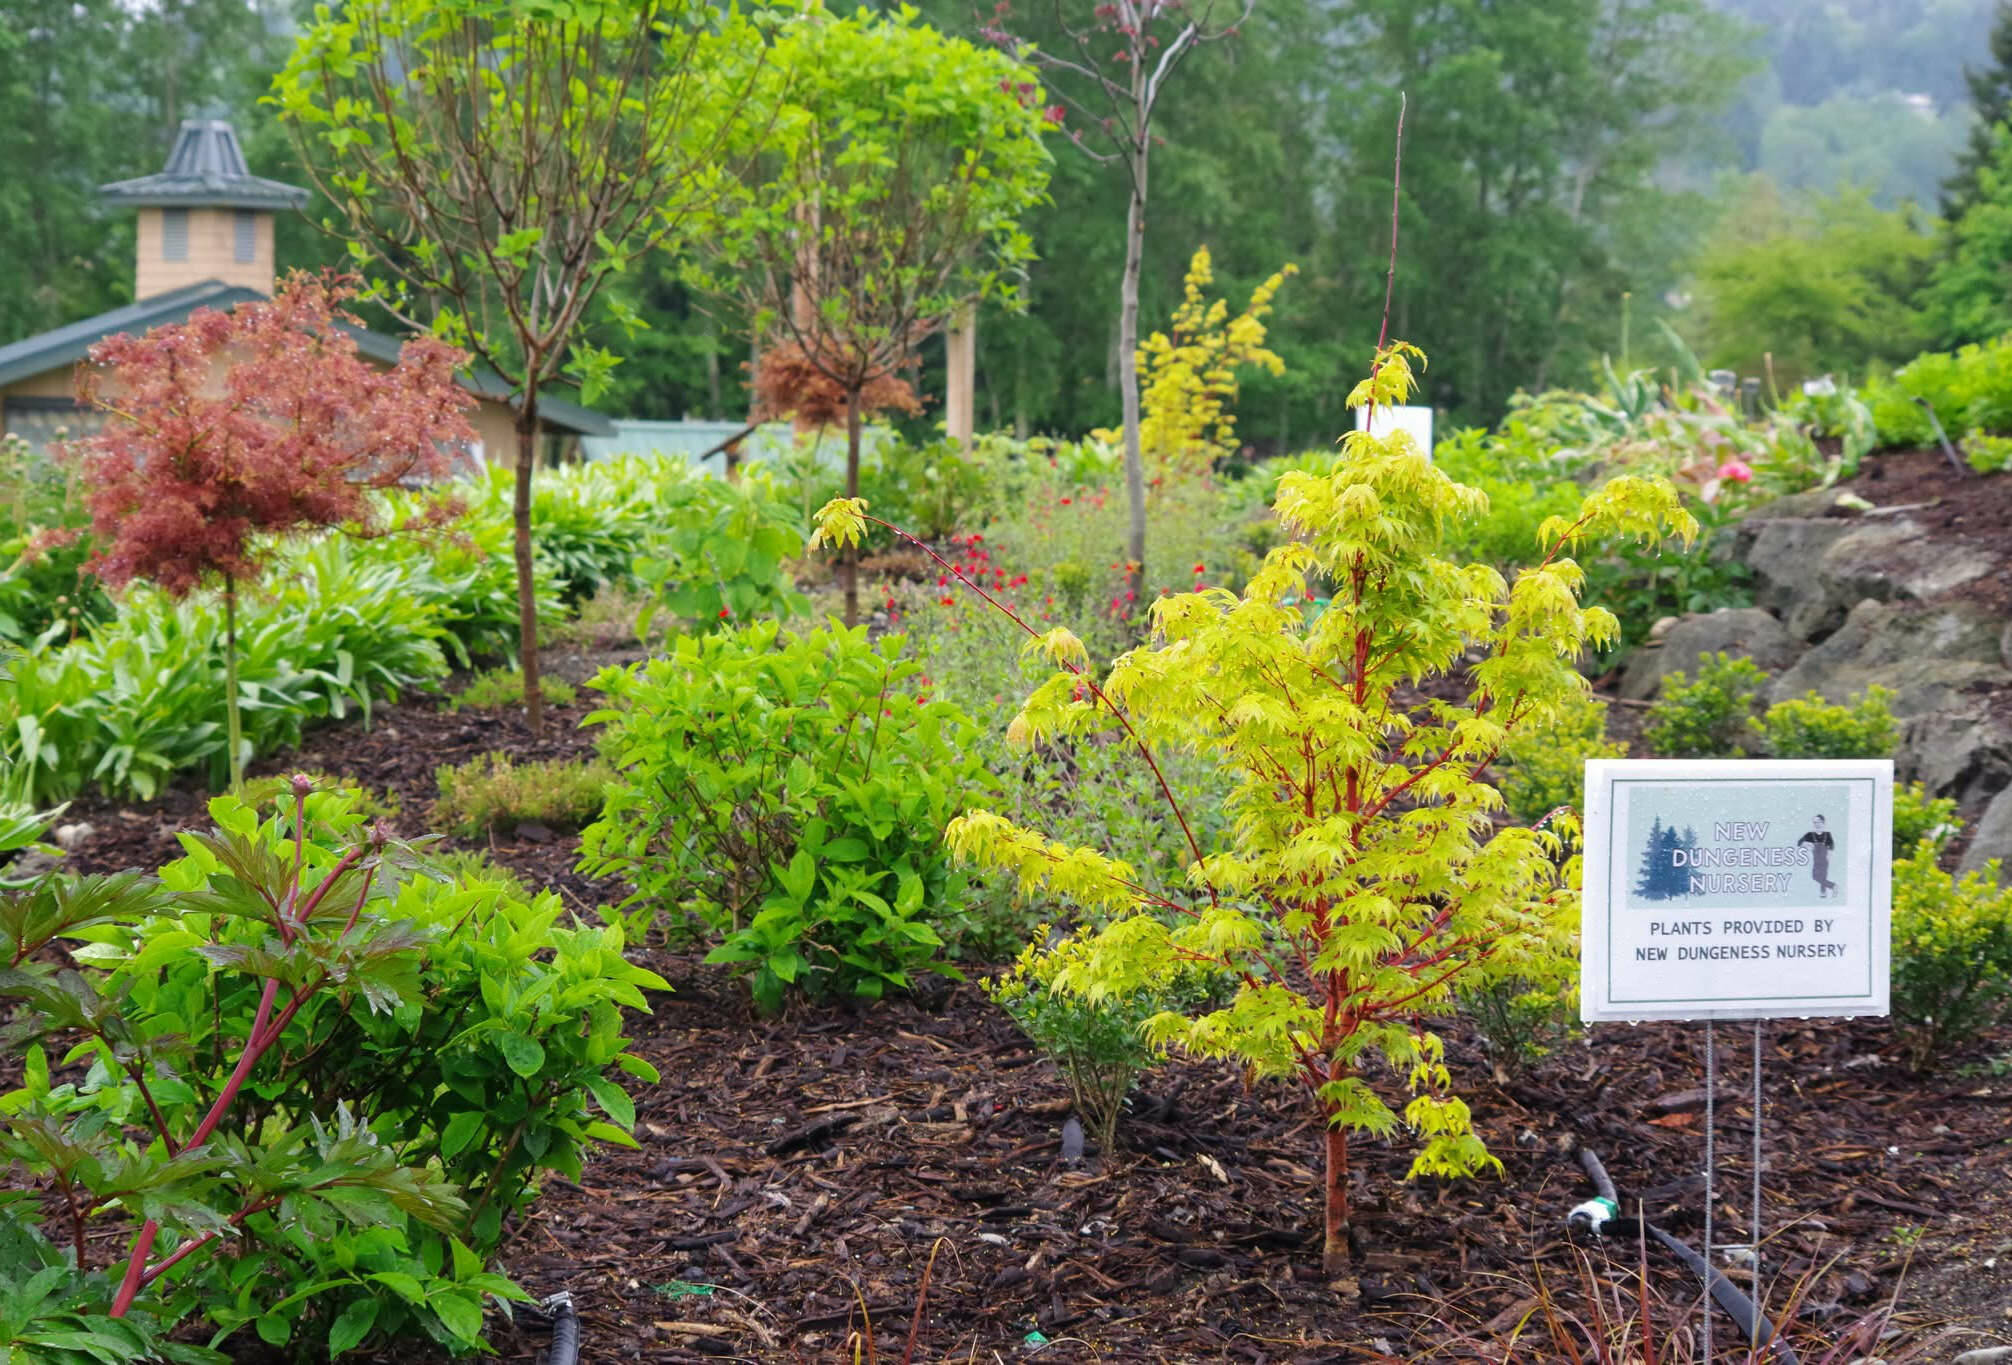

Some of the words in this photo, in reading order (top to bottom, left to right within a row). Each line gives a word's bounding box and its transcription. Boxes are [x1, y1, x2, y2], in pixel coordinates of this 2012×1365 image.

[1714, 821, 1770, 842] NEW
[1671, 847, 1810, 868] DUNGENESS
[1689, 872, 1793, 894] NURSERY
[1650, 921, 1712, 936] PLANTS
[1723, 920, 1804, 935] PROVIDED
[1814, 919, 1834, 933] BY
[1636, 947, 1668, 961] NEW
[1678, 945, 1770, 960] DUNGENESS
[1776, 944, 1846, 959] NURSERY
